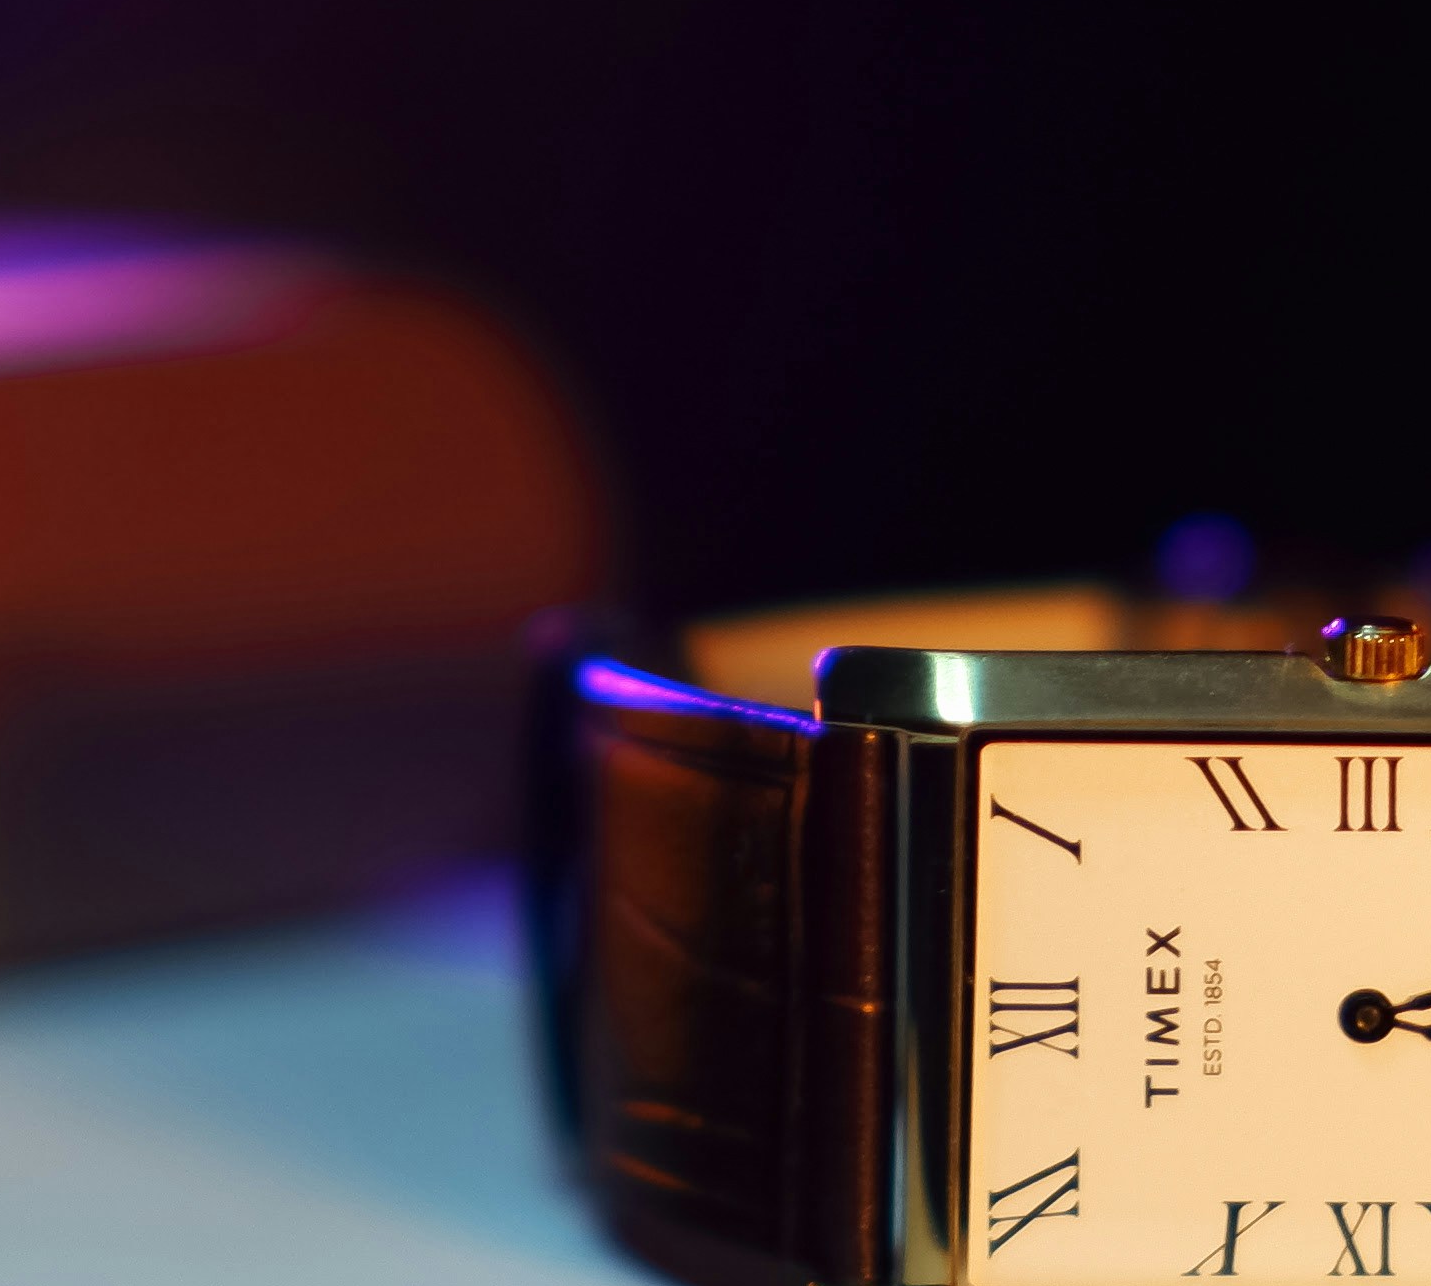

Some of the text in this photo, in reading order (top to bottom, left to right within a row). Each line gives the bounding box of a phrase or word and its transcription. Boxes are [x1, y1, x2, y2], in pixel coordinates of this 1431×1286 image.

[989, 792, 1082, 865] I
[1183, 755, 1289, 832] II
[1333, 755, 1404, 832] III
[988, 975, 1080, 1060] XII
[1143, 925, 1182, 1110] TIMEX
[1202, 958, 1224, 1077] ESTD. 1854
[987, 1146, 1080, 1260] XI
[1180, 1200, 1287, 1277] X
